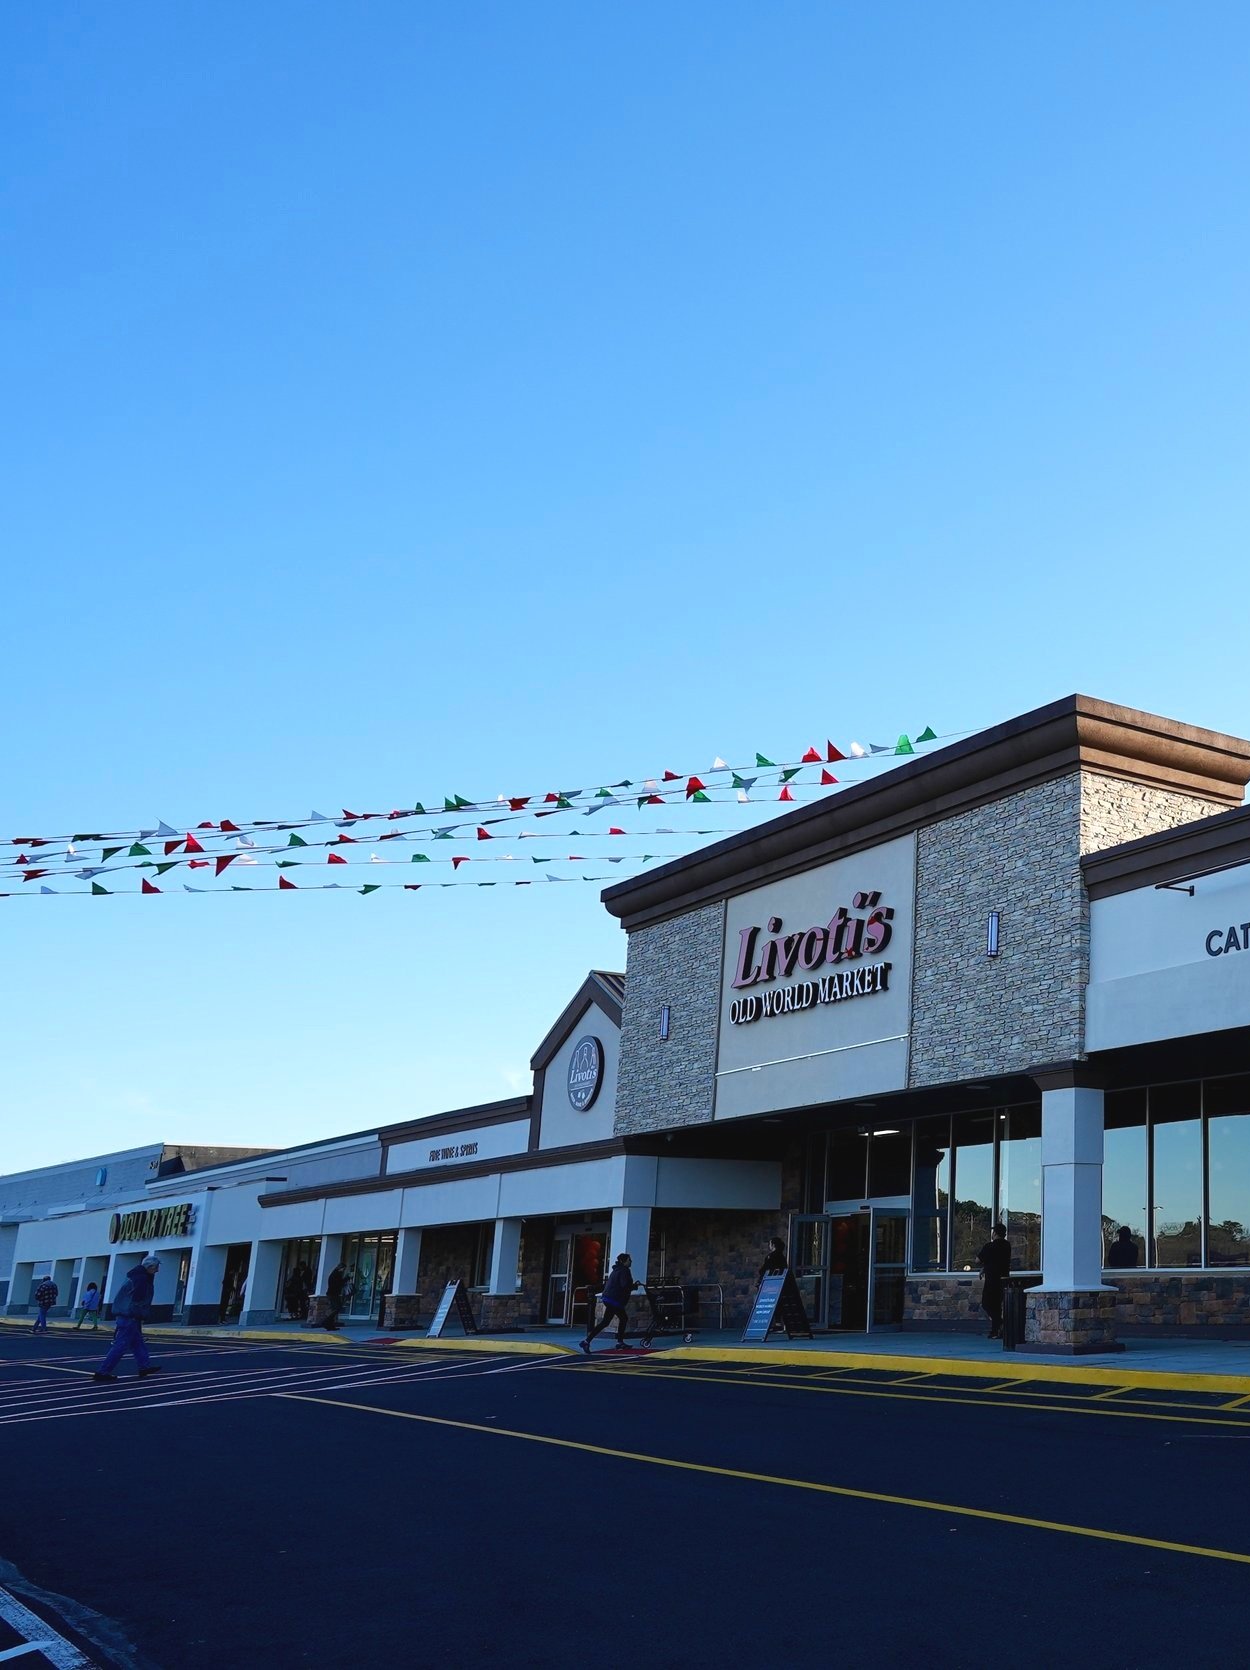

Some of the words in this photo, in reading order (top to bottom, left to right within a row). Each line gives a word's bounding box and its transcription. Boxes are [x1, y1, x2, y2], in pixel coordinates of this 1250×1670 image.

[731, 890, 894, 989] Livoti's
[729, 995, 759, 1025] OLD
[762, 980, 814, 1018] WORLD
[817, 962, 890, 1005] MARKET
[120, 1209, 159, 1242] DOLLAR
[159, 1203, 191, 1238] TREE
